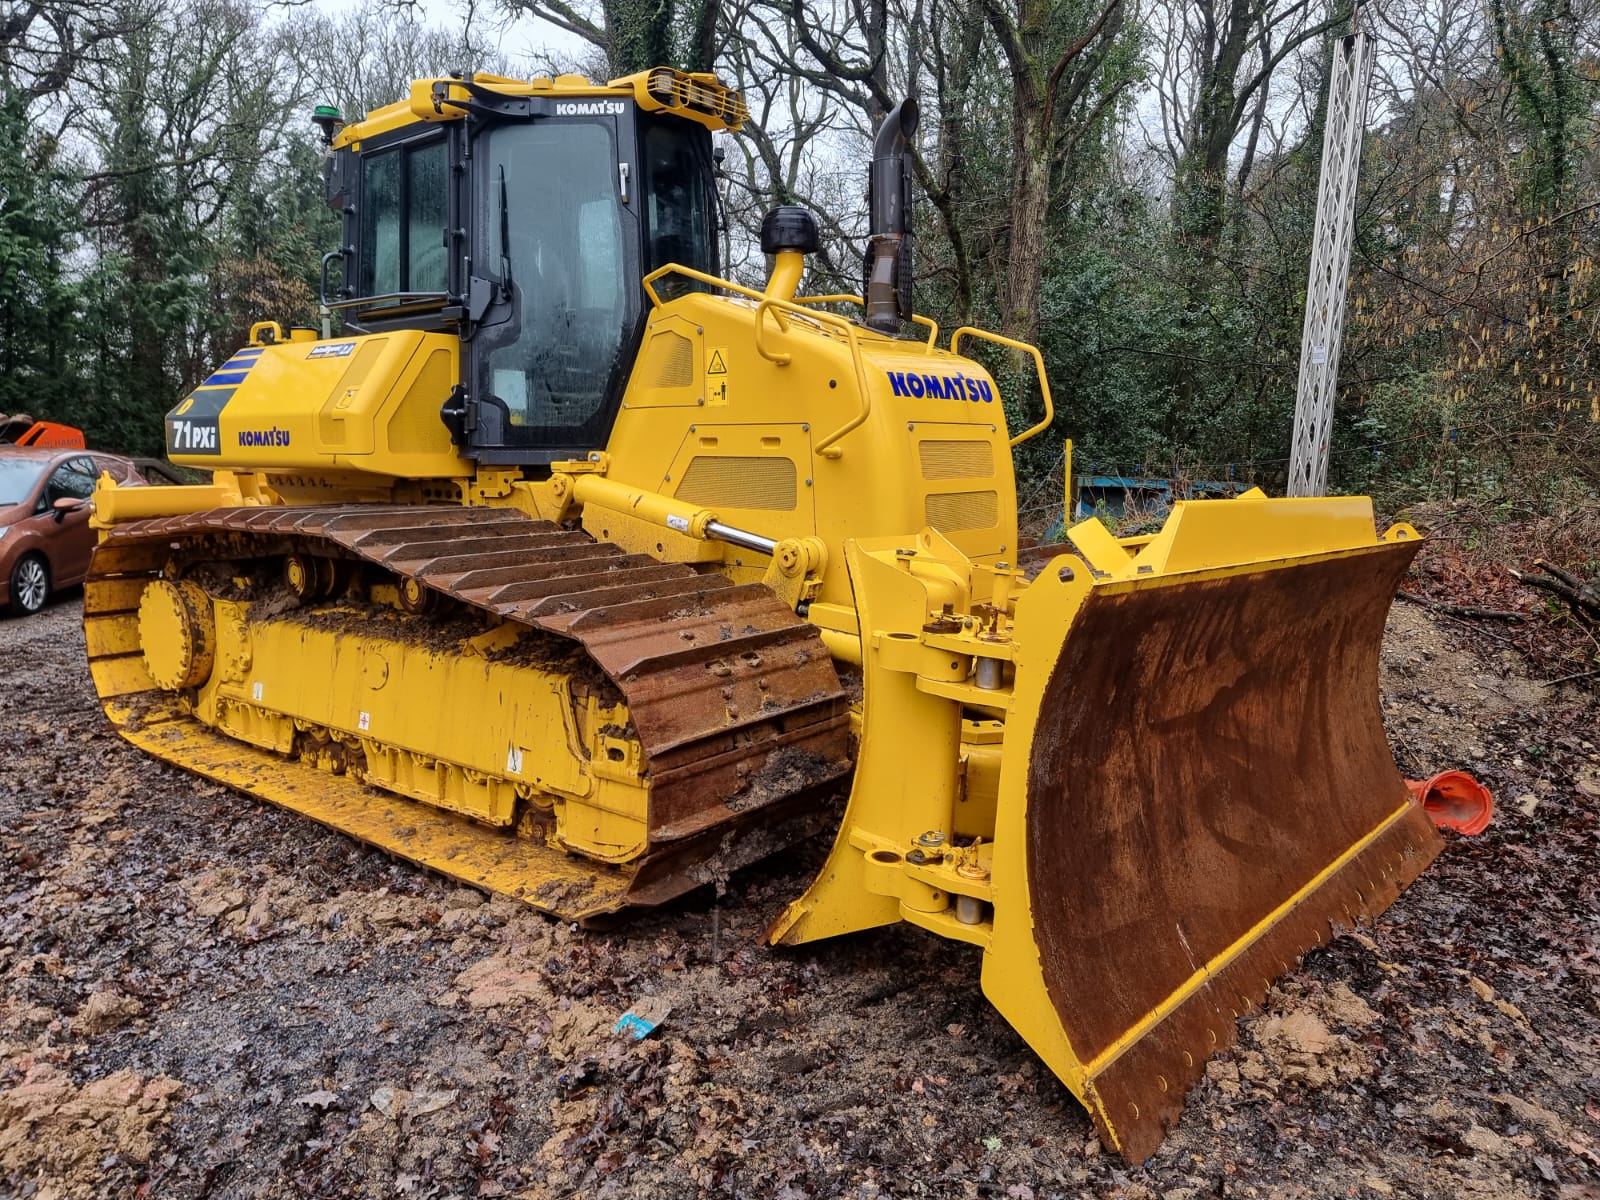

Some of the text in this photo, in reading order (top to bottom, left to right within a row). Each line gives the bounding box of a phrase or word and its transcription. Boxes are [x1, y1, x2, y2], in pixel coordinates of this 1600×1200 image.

[556, 100, 625, 115] KOMATSU
[887, 371, 993, 403] KOMATSU
[173, 420, 216, 449] 71PXi
[238, 425, 290, 447] KOMATSU
